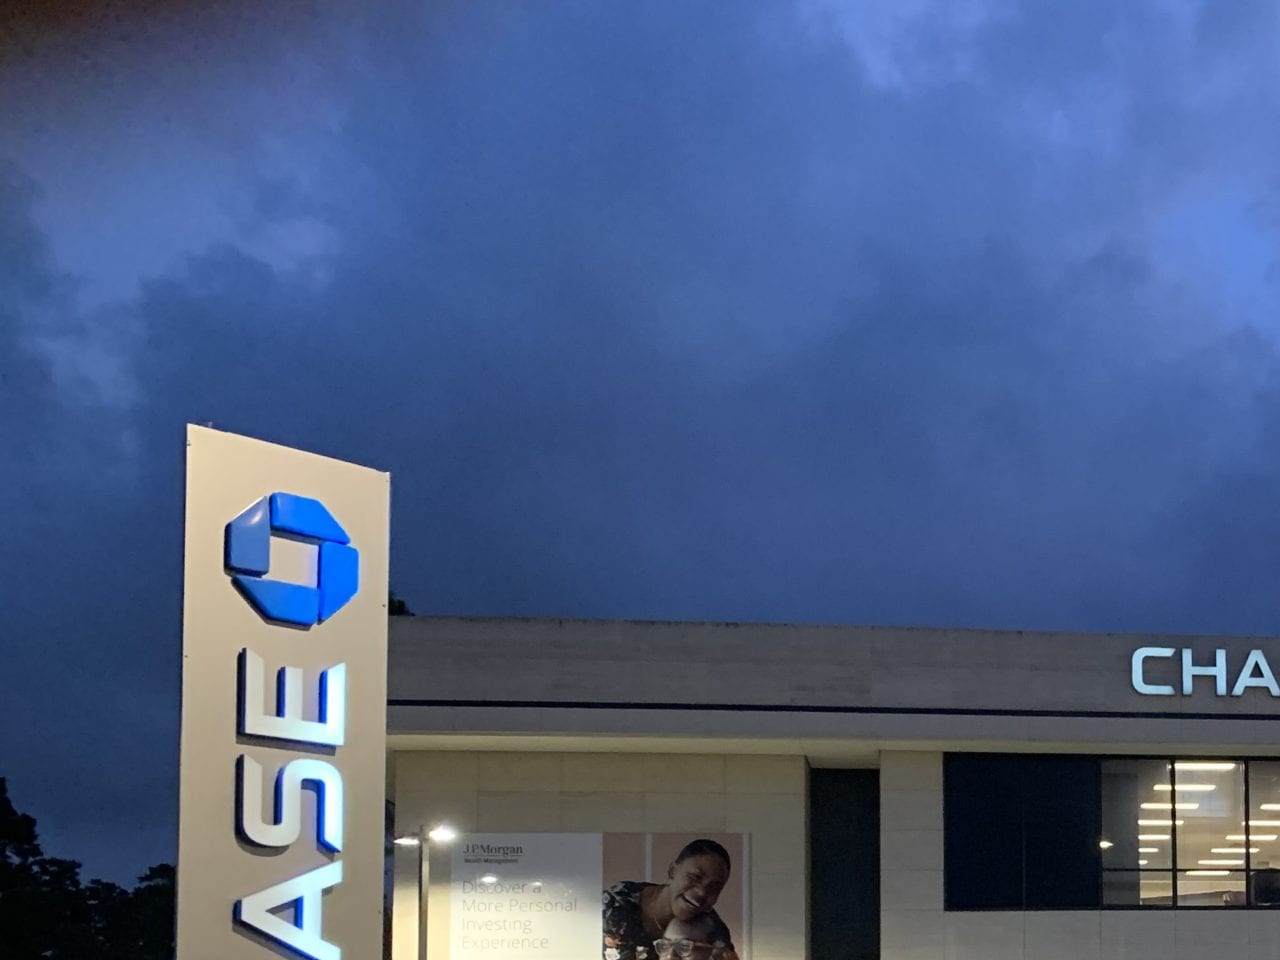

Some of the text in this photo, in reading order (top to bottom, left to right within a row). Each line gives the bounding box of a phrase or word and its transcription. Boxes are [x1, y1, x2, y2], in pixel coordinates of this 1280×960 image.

[462, 880, 542, 894] Discover a
[462, 898, 577, 913] More Personal
[462, 918, 532, 934] Investing
[462, 936, 549, 951] Experience
